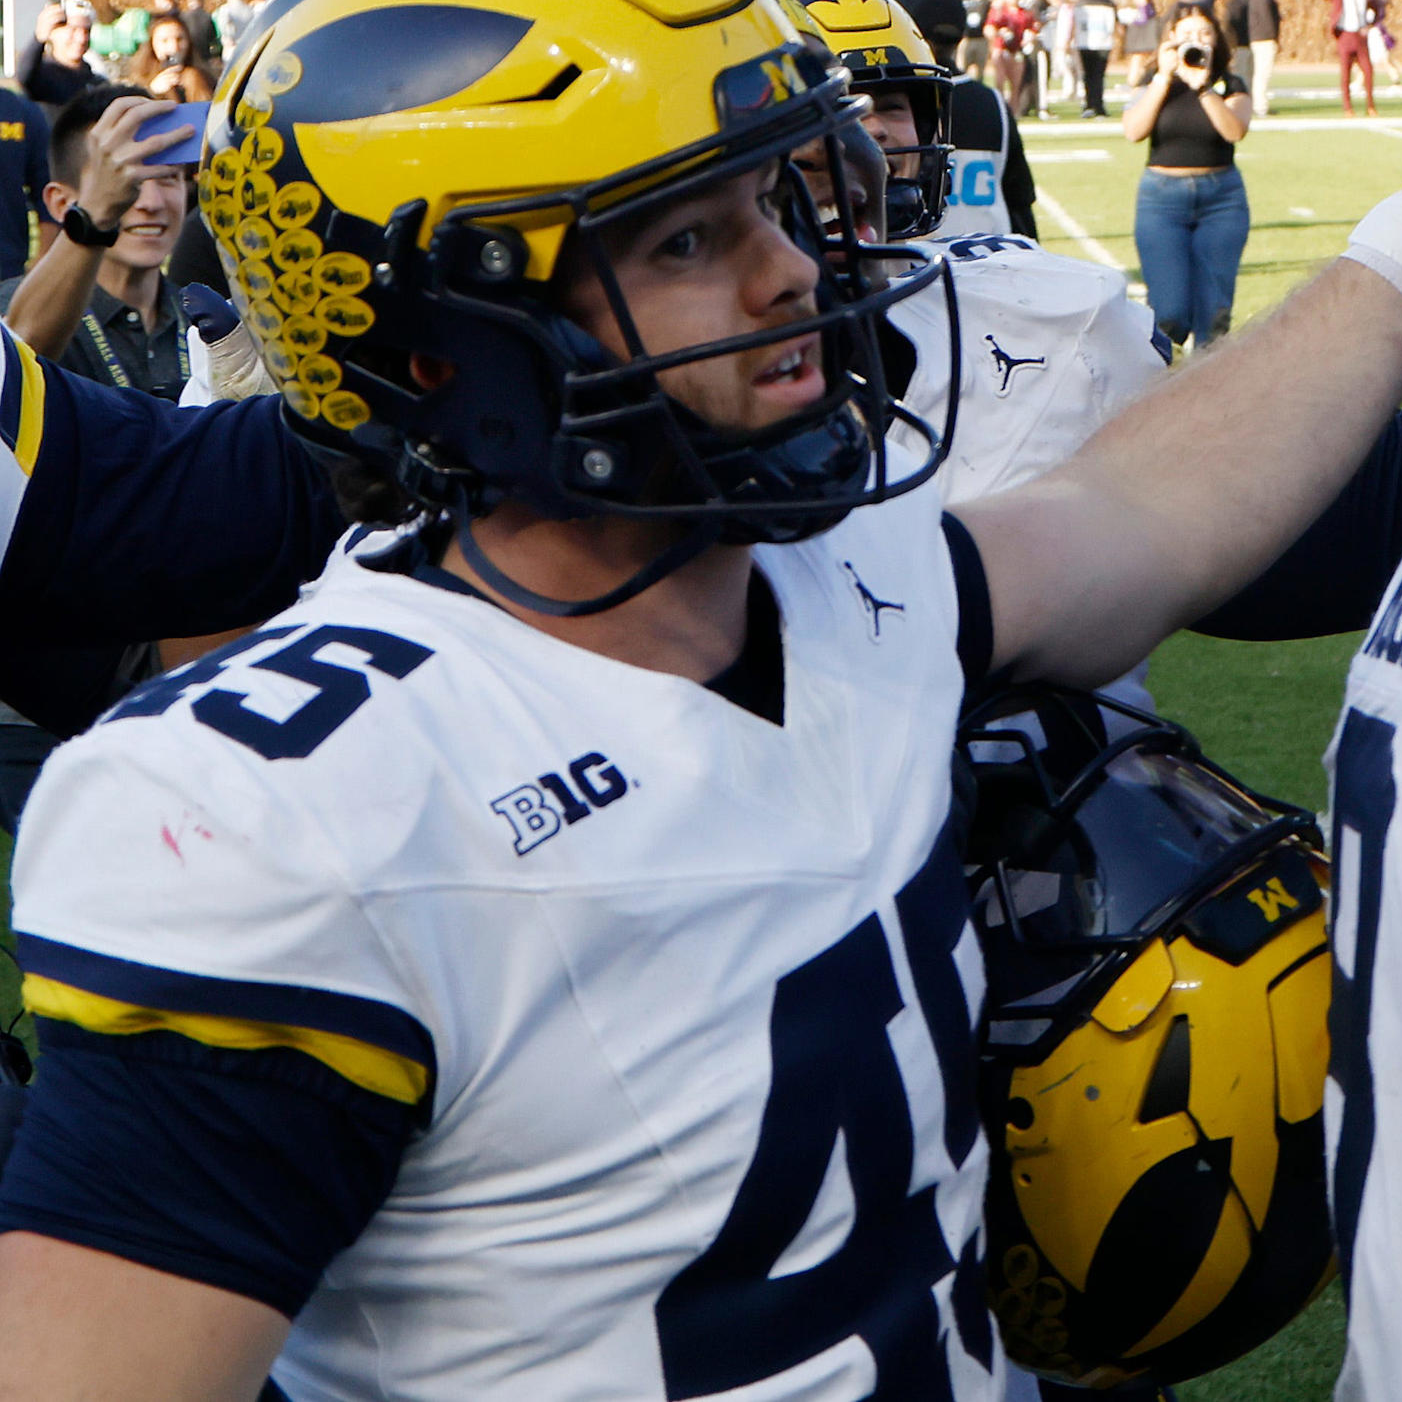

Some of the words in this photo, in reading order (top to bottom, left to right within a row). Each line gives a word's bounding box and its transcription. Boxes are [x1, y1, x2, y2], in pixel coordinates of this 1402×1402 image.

[760, 52, 808, 103] M
[863, 47, 889, 66] M
[1247, 877, 1299, 924] M
